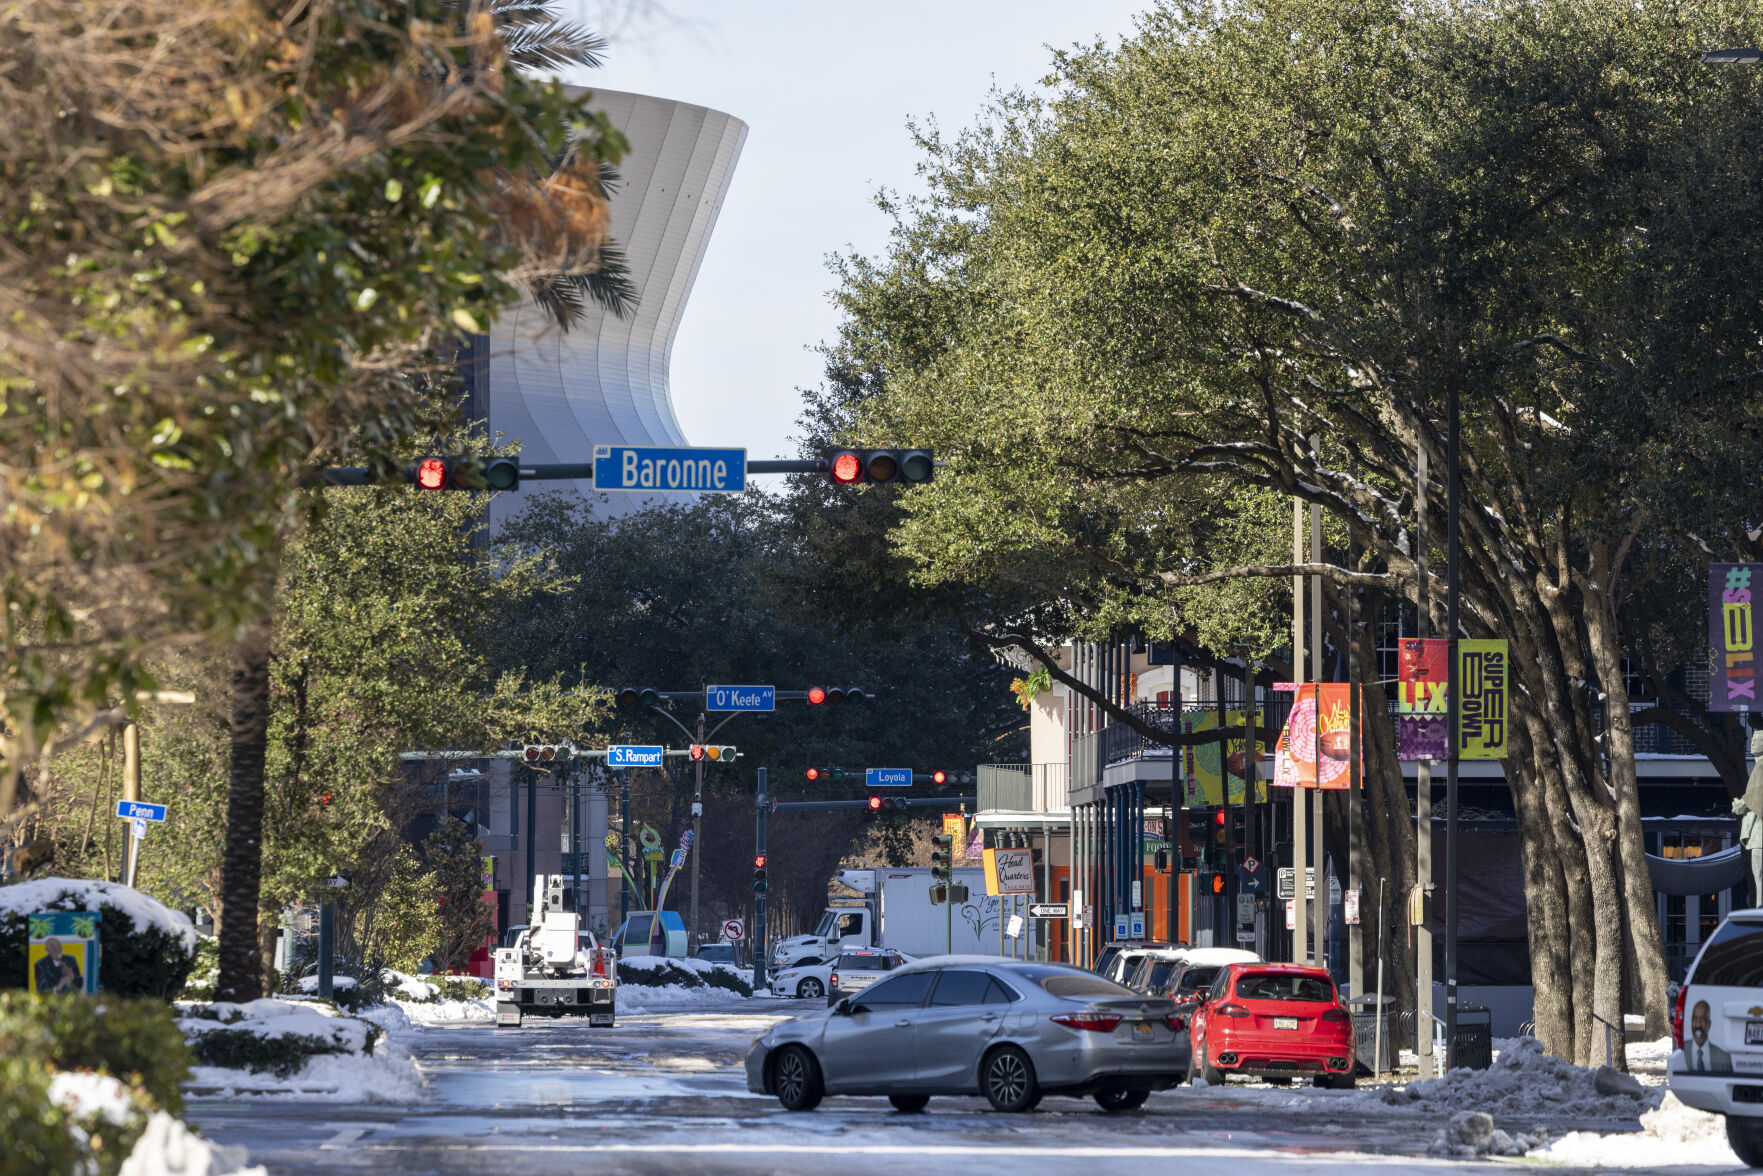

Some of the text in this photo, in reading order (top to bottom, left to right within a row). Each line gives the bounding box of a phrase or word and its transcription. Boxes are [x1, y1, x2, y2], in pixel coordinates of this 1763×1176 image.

[622, 450, 727, 488] Baronne
[716, 690, 773, 706] O'Keefe AV
[1399, 682, 1448, 713] LIX
[1462, 652, 1482, 748] BOWL
[1483, 651, 1504, 748] SUPER
[1281, 729, 1291, 776] BOWL LIX
[878, 770, 905, 784] Loyola
[129, 804, 154, 818] Penn
[998, 853, 1023, 871] Head
[999, 867, 1031, 886] Quarters
